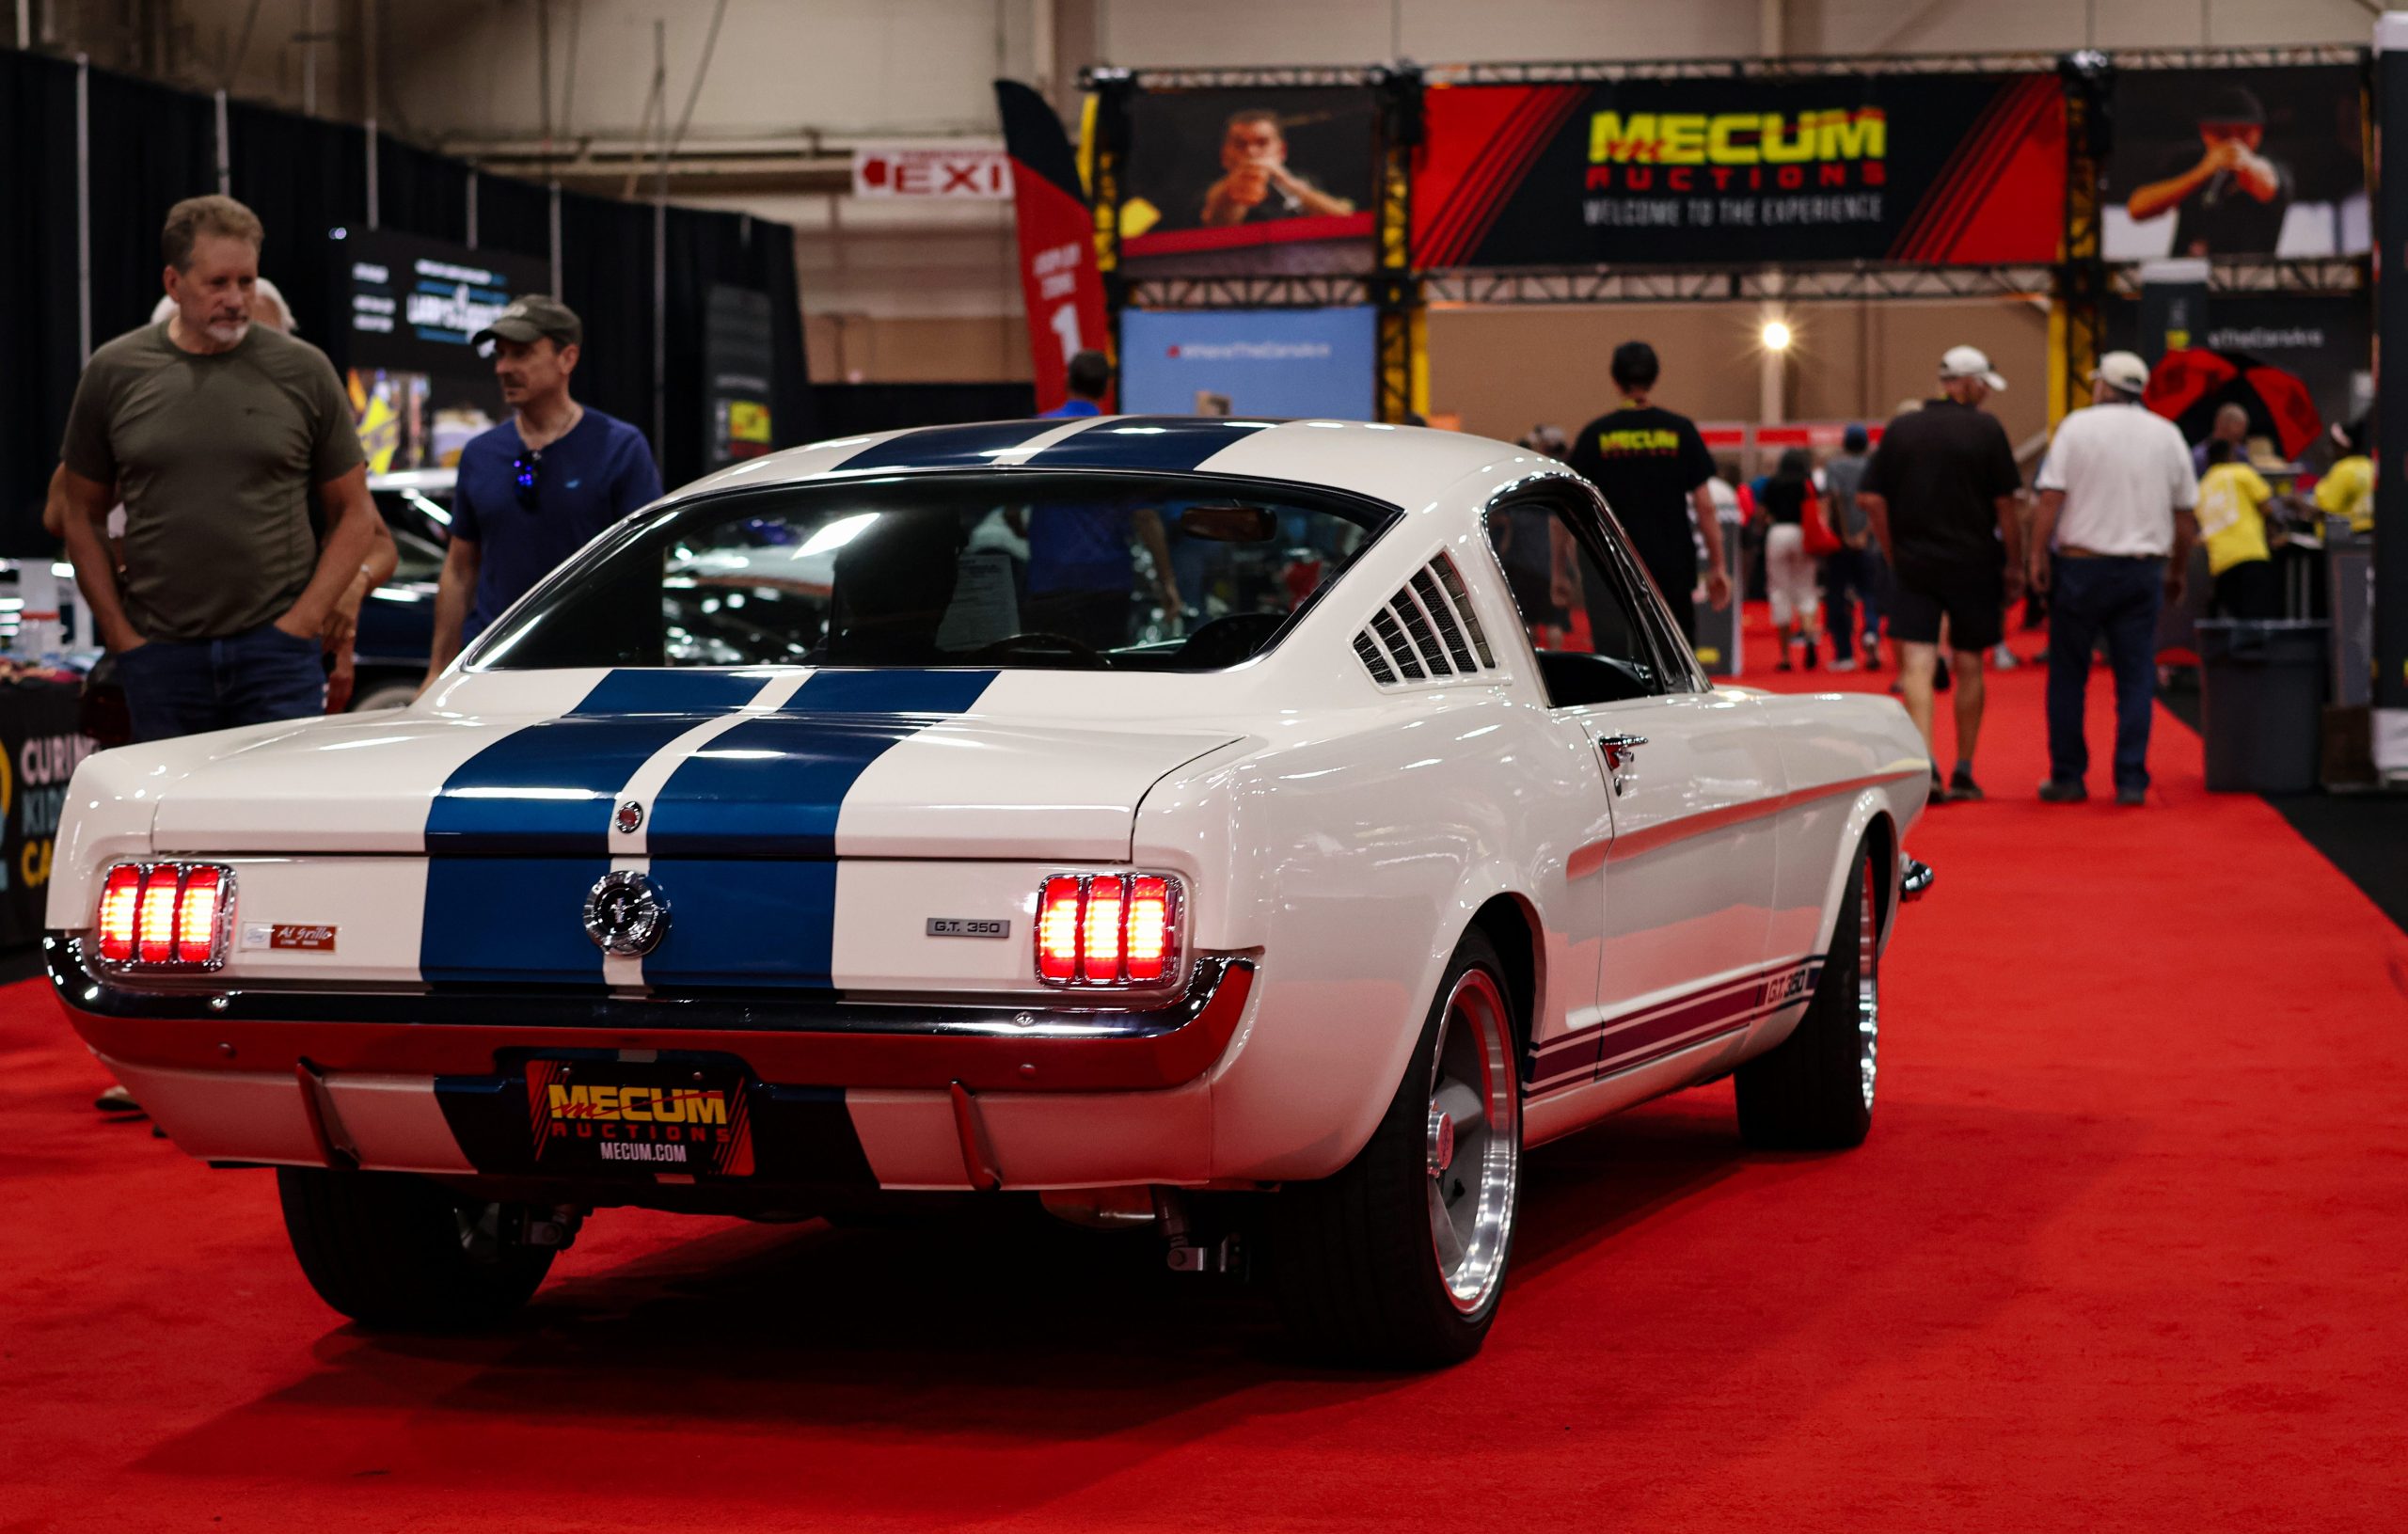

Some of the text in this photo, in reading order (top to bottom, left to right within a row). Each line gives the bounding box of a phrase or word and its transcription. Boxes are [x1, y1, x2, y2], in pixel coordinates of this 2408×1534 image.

[1589, 106, 1887, 164] MECUM
[1586, 161, 1887, 191] AUCTIONS
[1584, 193, 1882, 226] WELCOME TO THE EXPERIENCE
[21, 733, 100, 784] CURIN
[934, 921, 1001, 933] G.T. 350
[548, 1083, 727, 1124] MECUM
[551, 1121, 731, 1143] AUCTIONS
[600, 1142, 687, 1162] MECUM.COM
